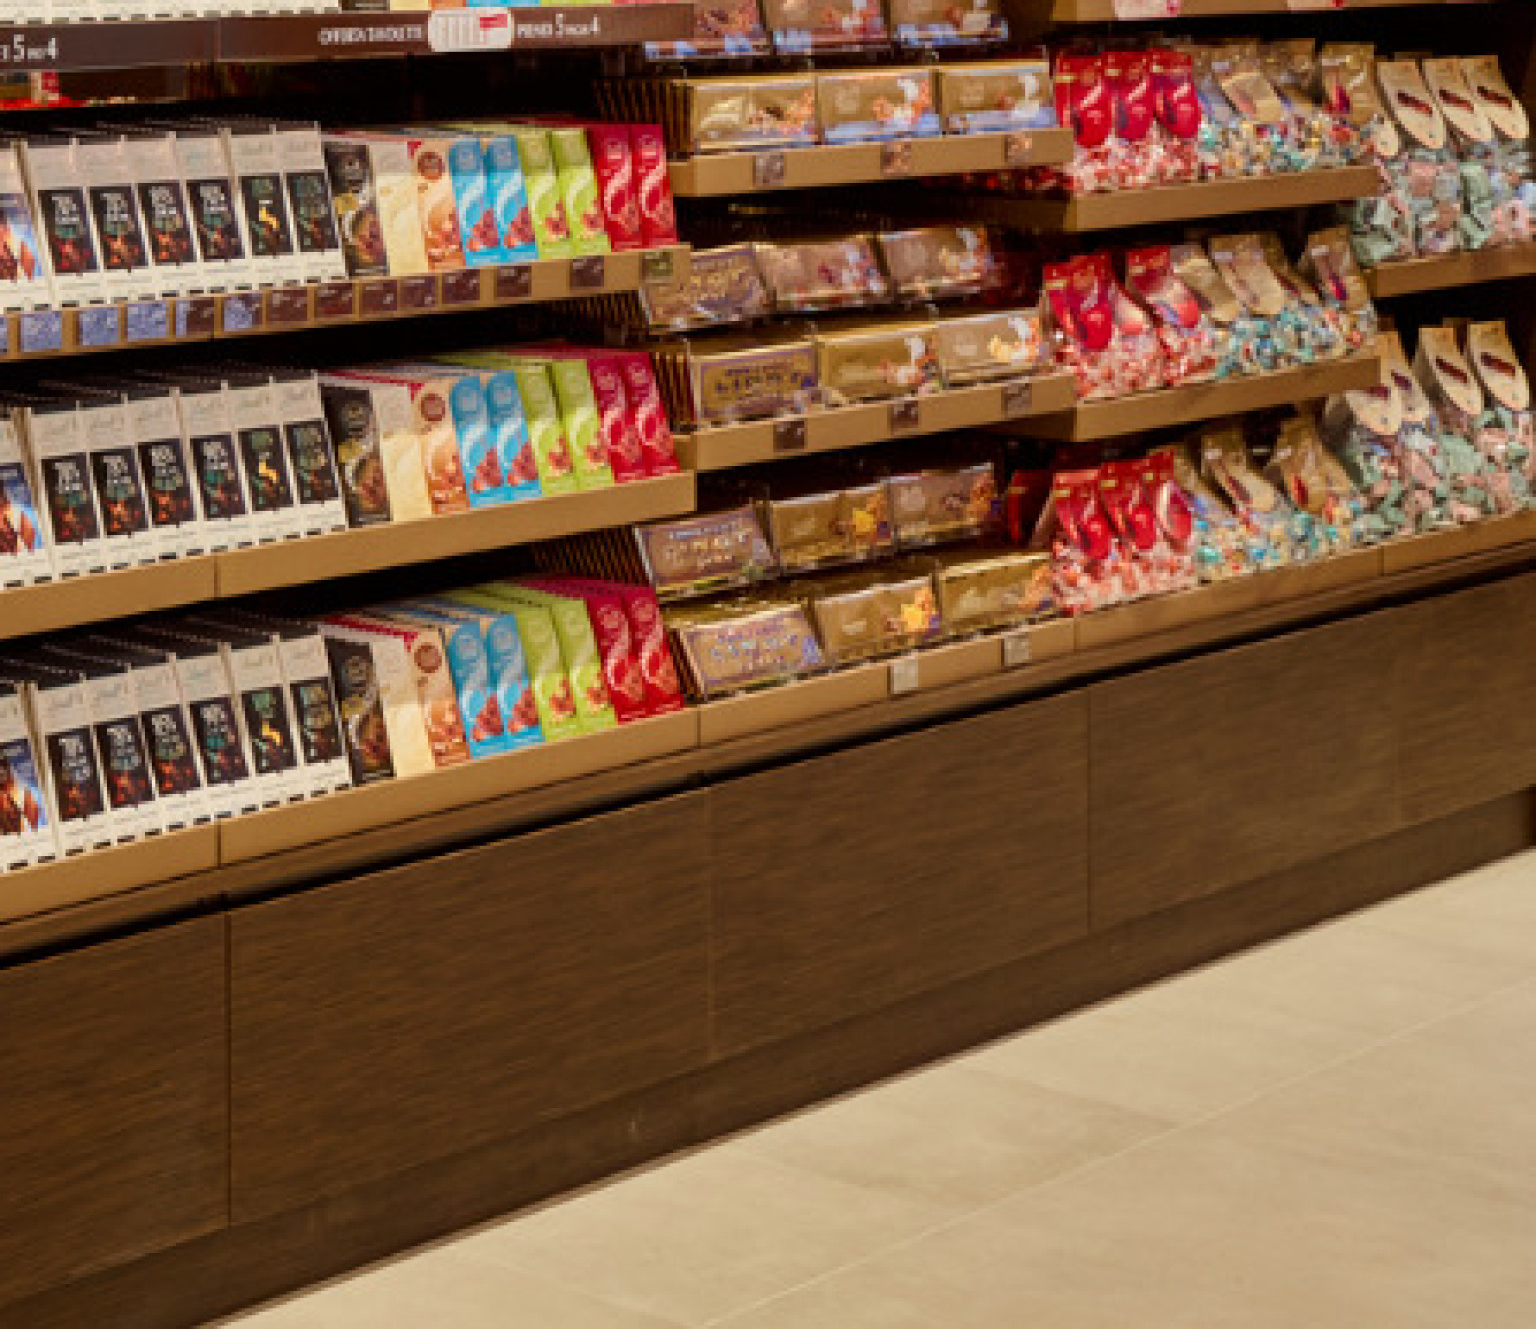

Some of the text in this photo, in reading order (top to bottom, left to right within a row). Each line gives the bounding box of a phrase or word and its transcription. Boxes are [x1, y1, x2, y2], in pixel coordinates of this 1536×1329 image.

[555, 13, 566, 36] 5
[590, 15, 600, 35] 4
[12, 36, 26, 61] 5
[46, 37, 59, 59] 4
